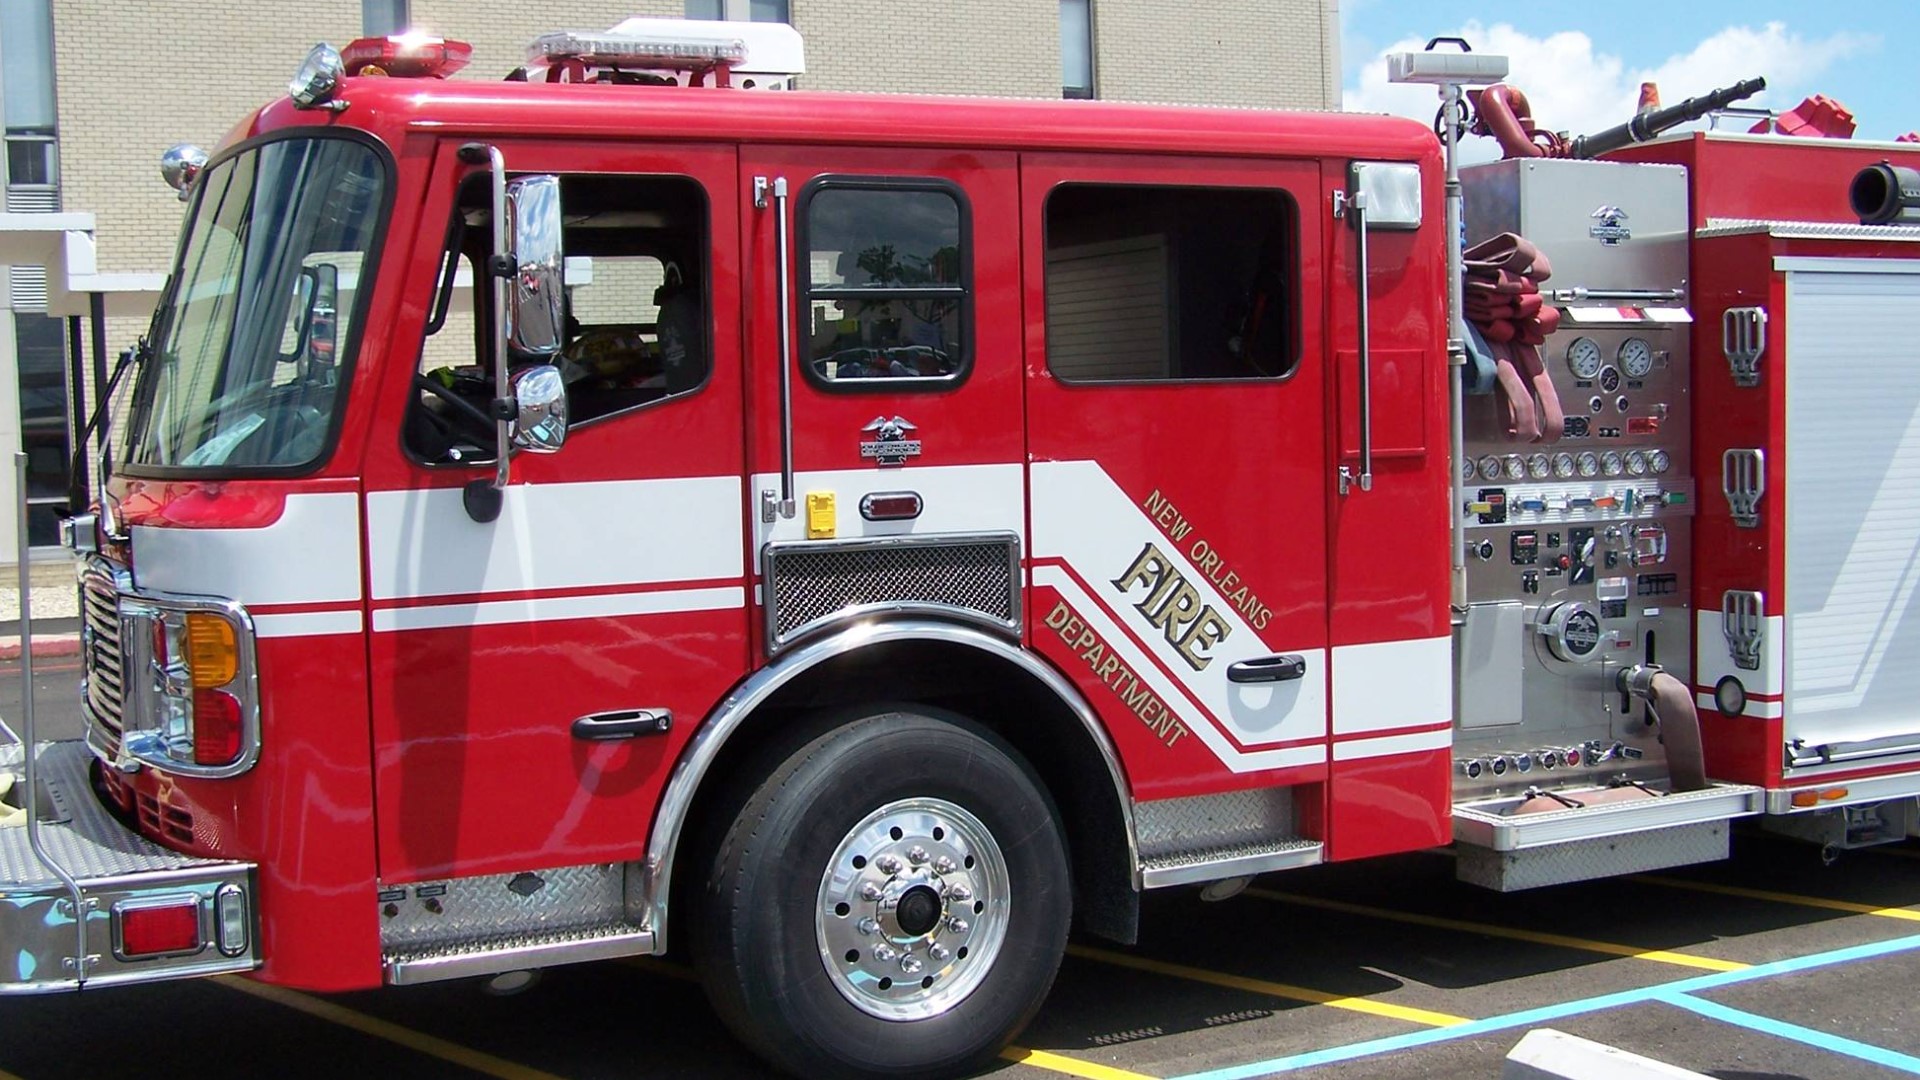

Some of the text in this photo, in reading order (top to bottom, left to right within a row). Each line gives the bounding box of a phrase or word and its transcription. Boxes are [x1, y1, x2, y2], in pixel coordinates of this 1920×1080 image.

[1110, 542, 1232, 671] FIRE
[1144, 489, 1273, 630] NEW ORLEANS
[1044, 602, 1188, 748] DEPARTMENT
